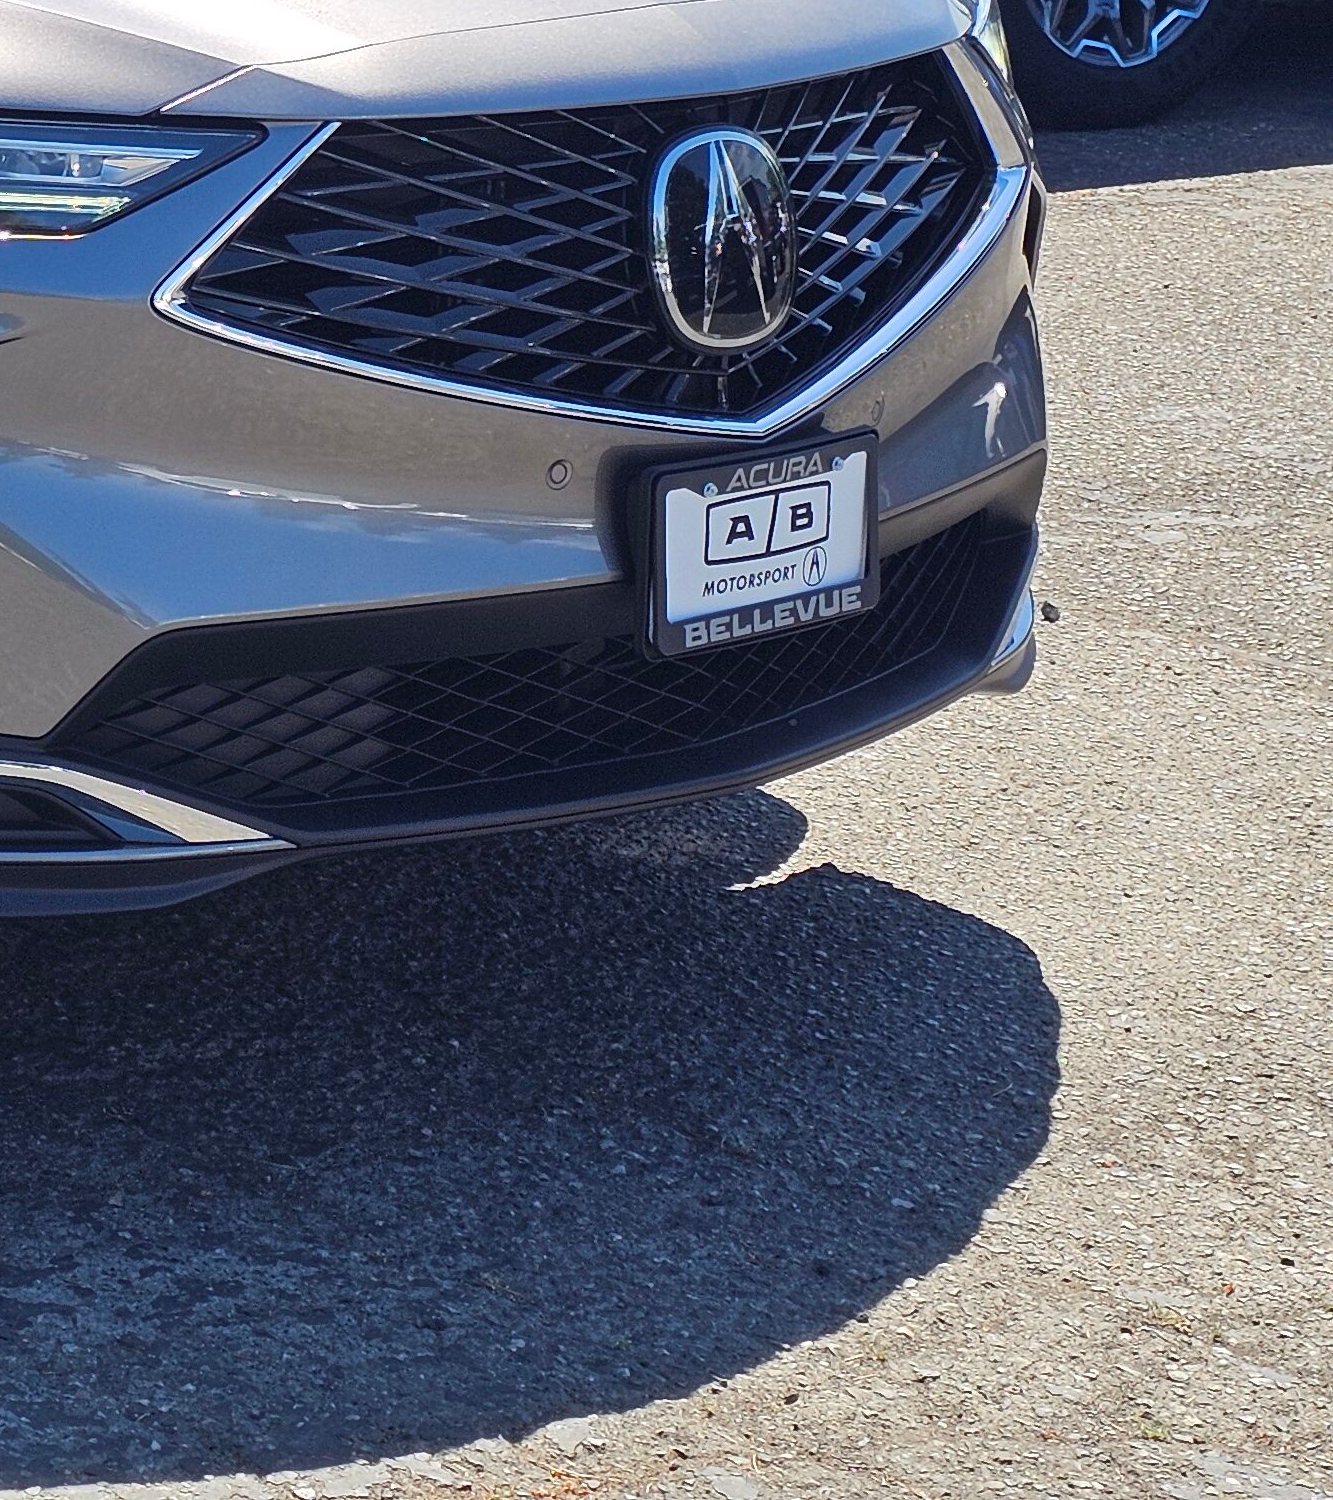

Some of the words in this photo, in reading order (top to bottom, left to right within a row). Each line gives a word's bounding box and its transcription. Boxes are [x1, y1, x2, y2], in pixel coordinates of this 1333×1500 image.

[727, 453, 822, 491] ACURA
[725, 514, 755, 546] A
[789, 501, 814, 532] B
[702, 564, 796, 596] MOTORSPORT
[683, 585, 862, 648] BELLEVUE
